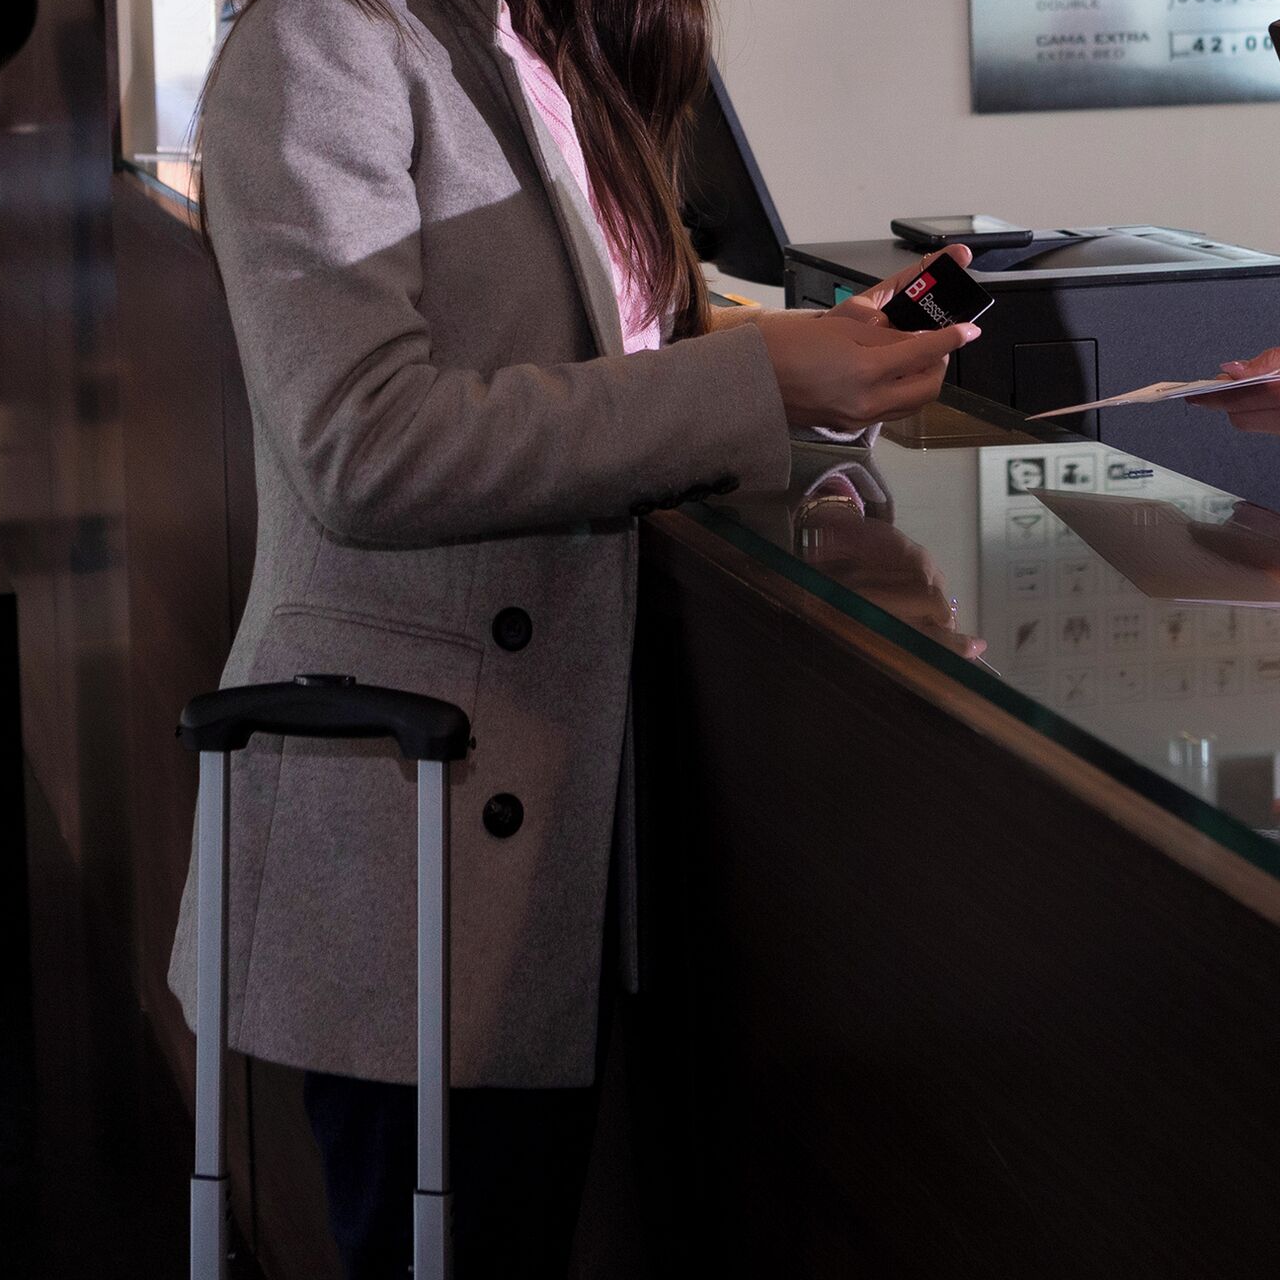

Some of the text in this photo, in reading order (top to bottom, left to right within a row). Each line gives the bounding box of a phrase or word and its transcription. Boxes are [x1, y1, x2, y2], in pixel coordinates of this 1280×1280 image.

[1035, 31, 1151, 47] CAMA EXTRA
[905, 278, 927, 298] B
